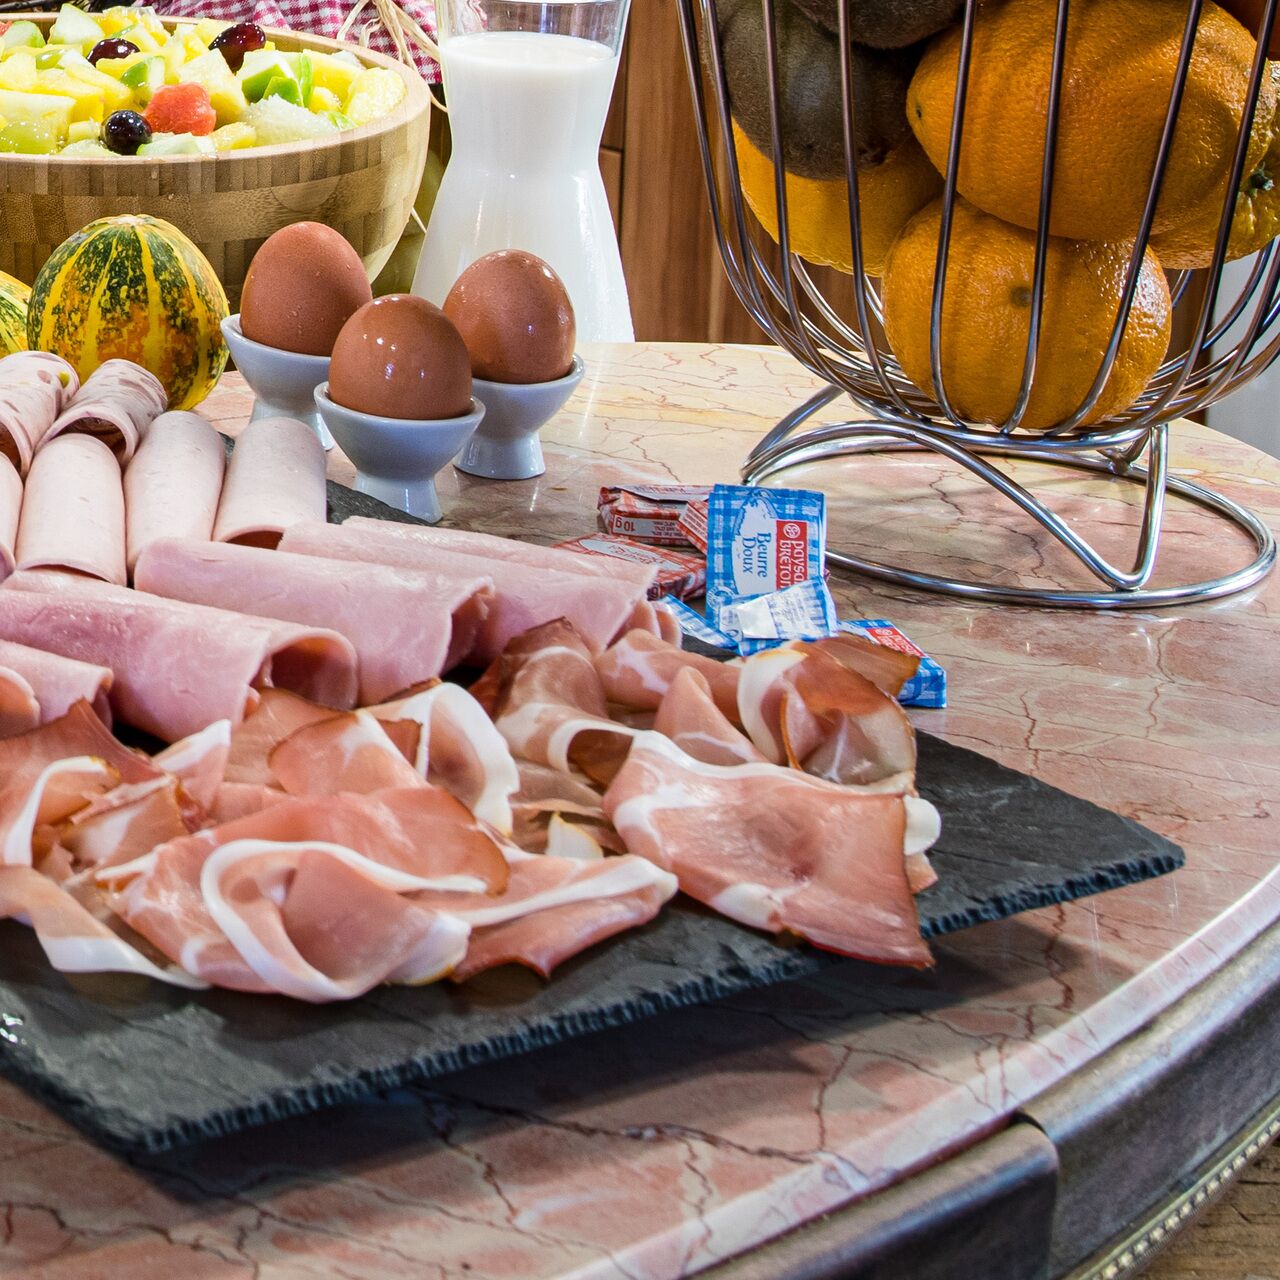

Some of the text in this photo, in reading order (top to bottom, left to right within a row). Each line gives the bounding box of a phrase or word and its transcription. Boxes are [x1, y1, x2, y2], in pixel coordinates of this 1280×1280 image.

[624, 521, 636, 532] 10
[742, 537, 757, 575] Doux
[757, 532, 772, 578] Beurre
[791, 539, 805, 584] paysa
